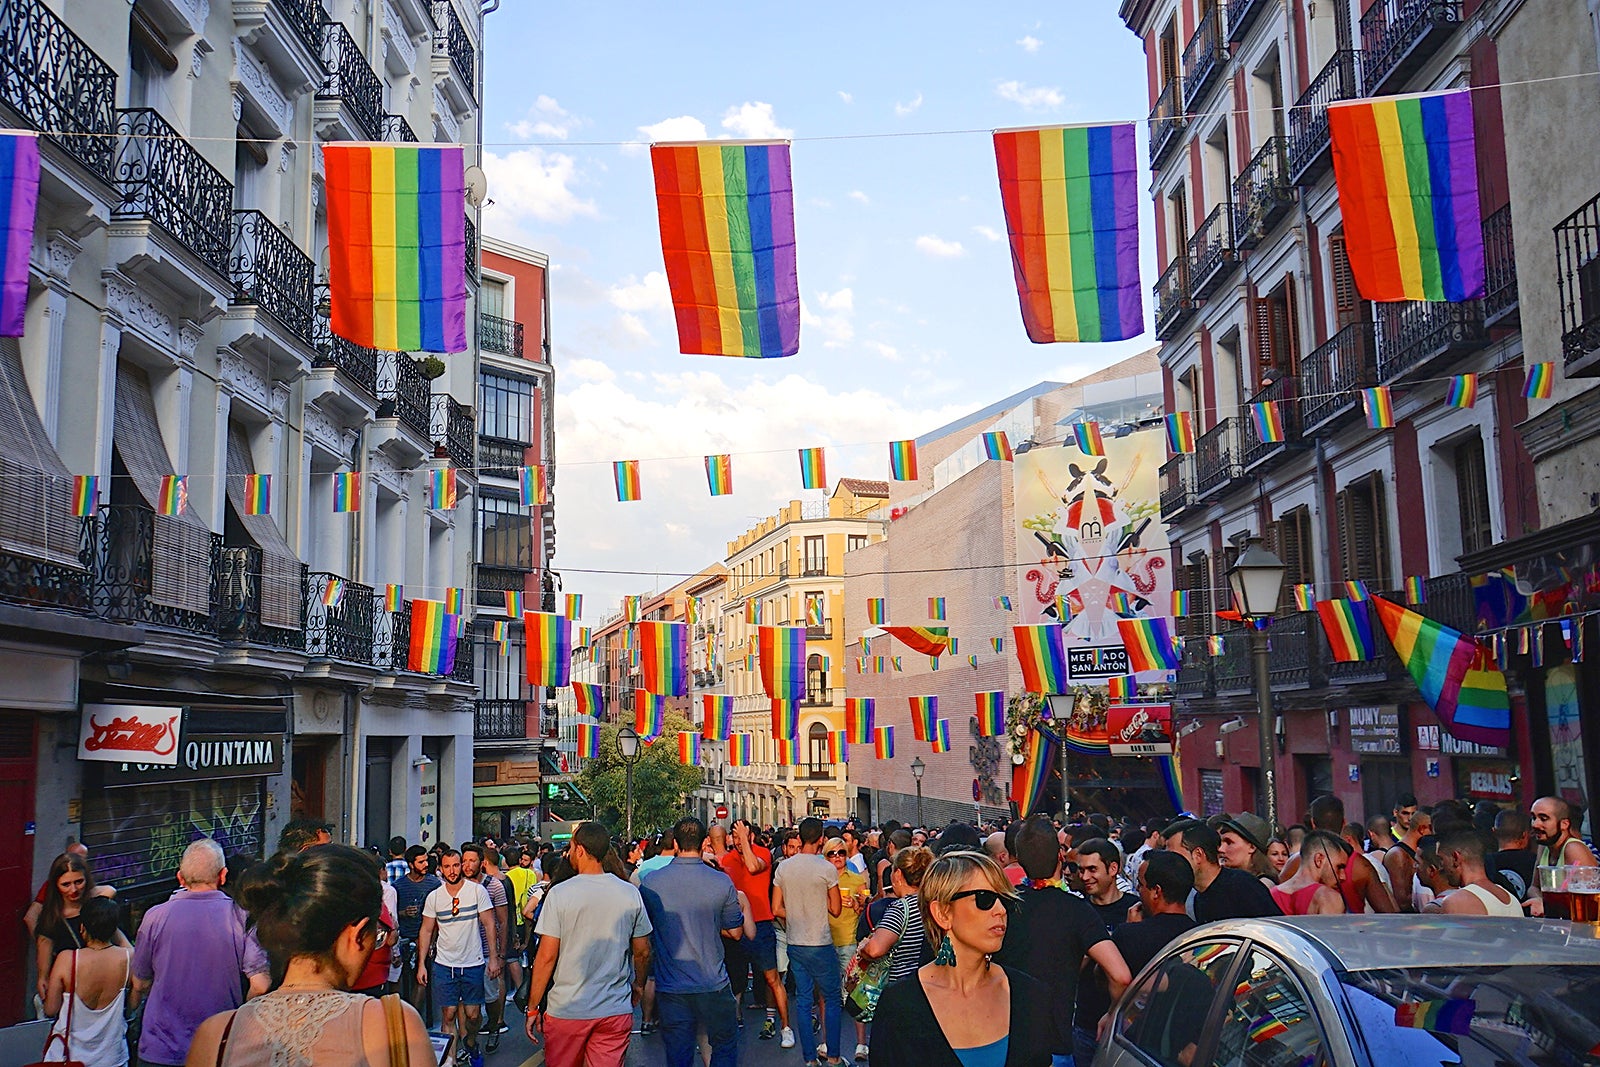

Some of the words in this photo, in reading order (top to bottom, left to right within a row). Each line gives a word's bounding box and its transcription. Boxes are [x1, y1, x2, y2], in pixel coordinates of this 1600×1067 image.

[1071, 652, 1125, 662] MERADO
[1071, 664, 1091, 672] SAN
[1093, 661, 1126, 671] ANTÓN
[1350, 708, 1379, 725] MUMY
[185, 740, 274, 771] QUINTANA
[1470, 772, 1512, 795] REBAJAS
